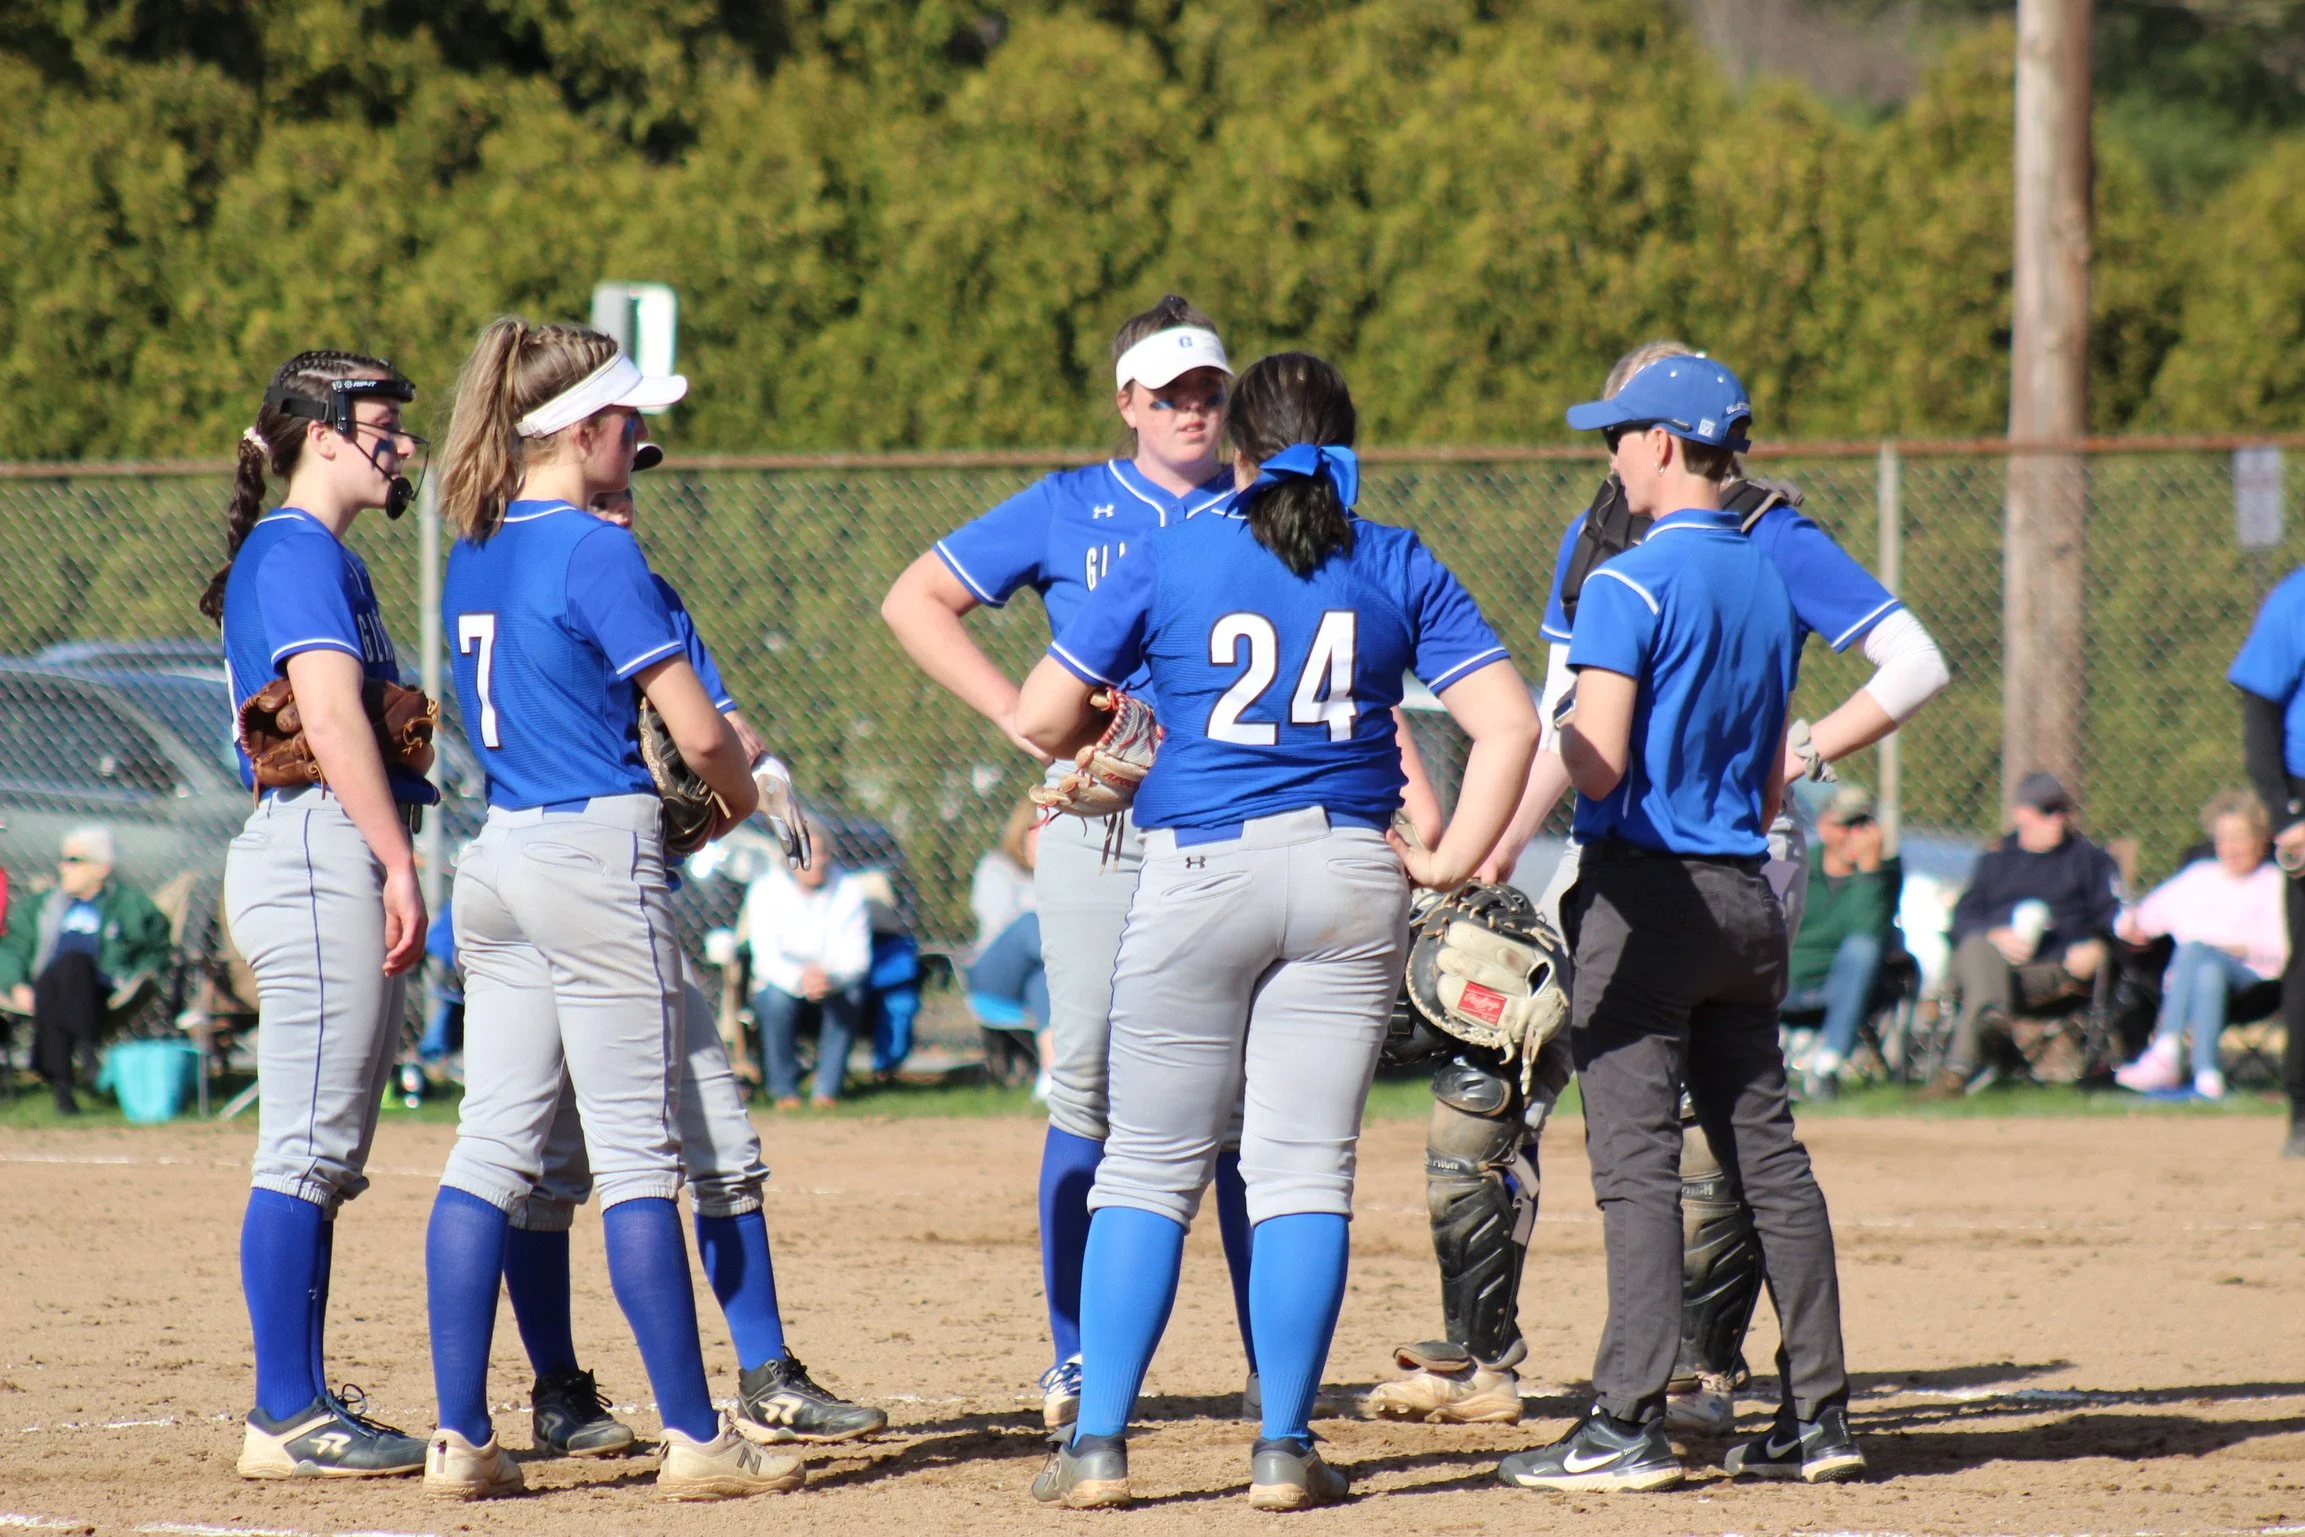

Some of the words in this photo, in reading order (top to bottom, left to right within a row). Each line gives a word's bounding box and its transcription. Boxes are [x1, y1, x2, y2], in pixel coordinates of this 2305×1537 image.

[458, 613, 500, 749] 7
[1205, 609, 1359, 746] 24
[736, 1446, 762, 1476] N
